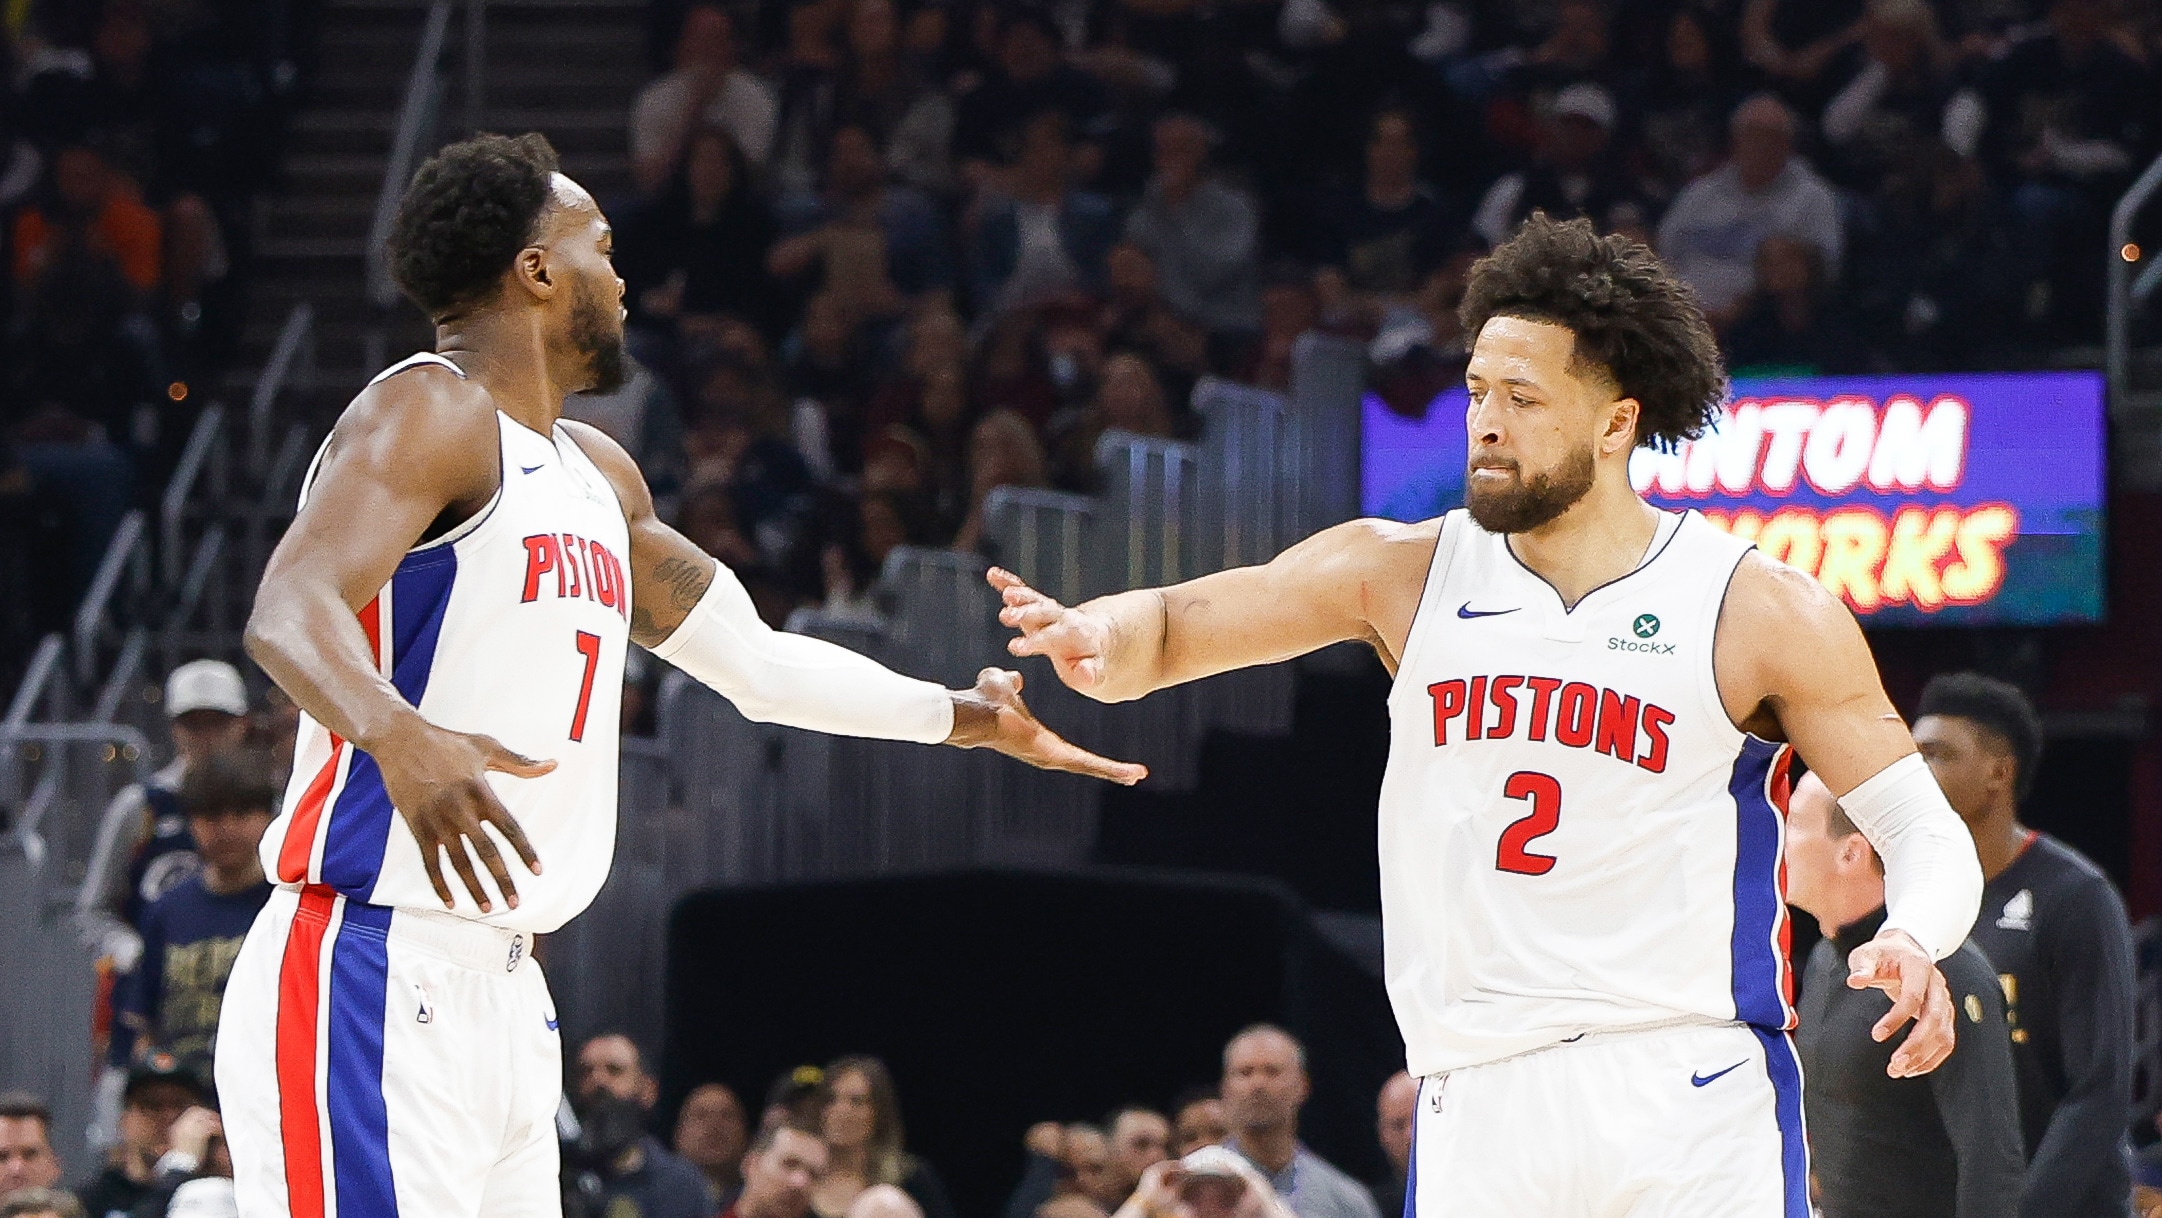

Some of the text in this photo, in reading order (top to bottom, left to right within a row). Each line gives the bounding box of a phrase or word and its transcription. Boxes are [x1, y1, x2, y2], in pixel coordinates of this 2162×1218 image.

[569, 629, 601, 743] 7
[1607, 637, 1676, 655] StockX
[1427, 674, 1675, 774] PISTONS
[1495, 770, 1562, 876] 2
